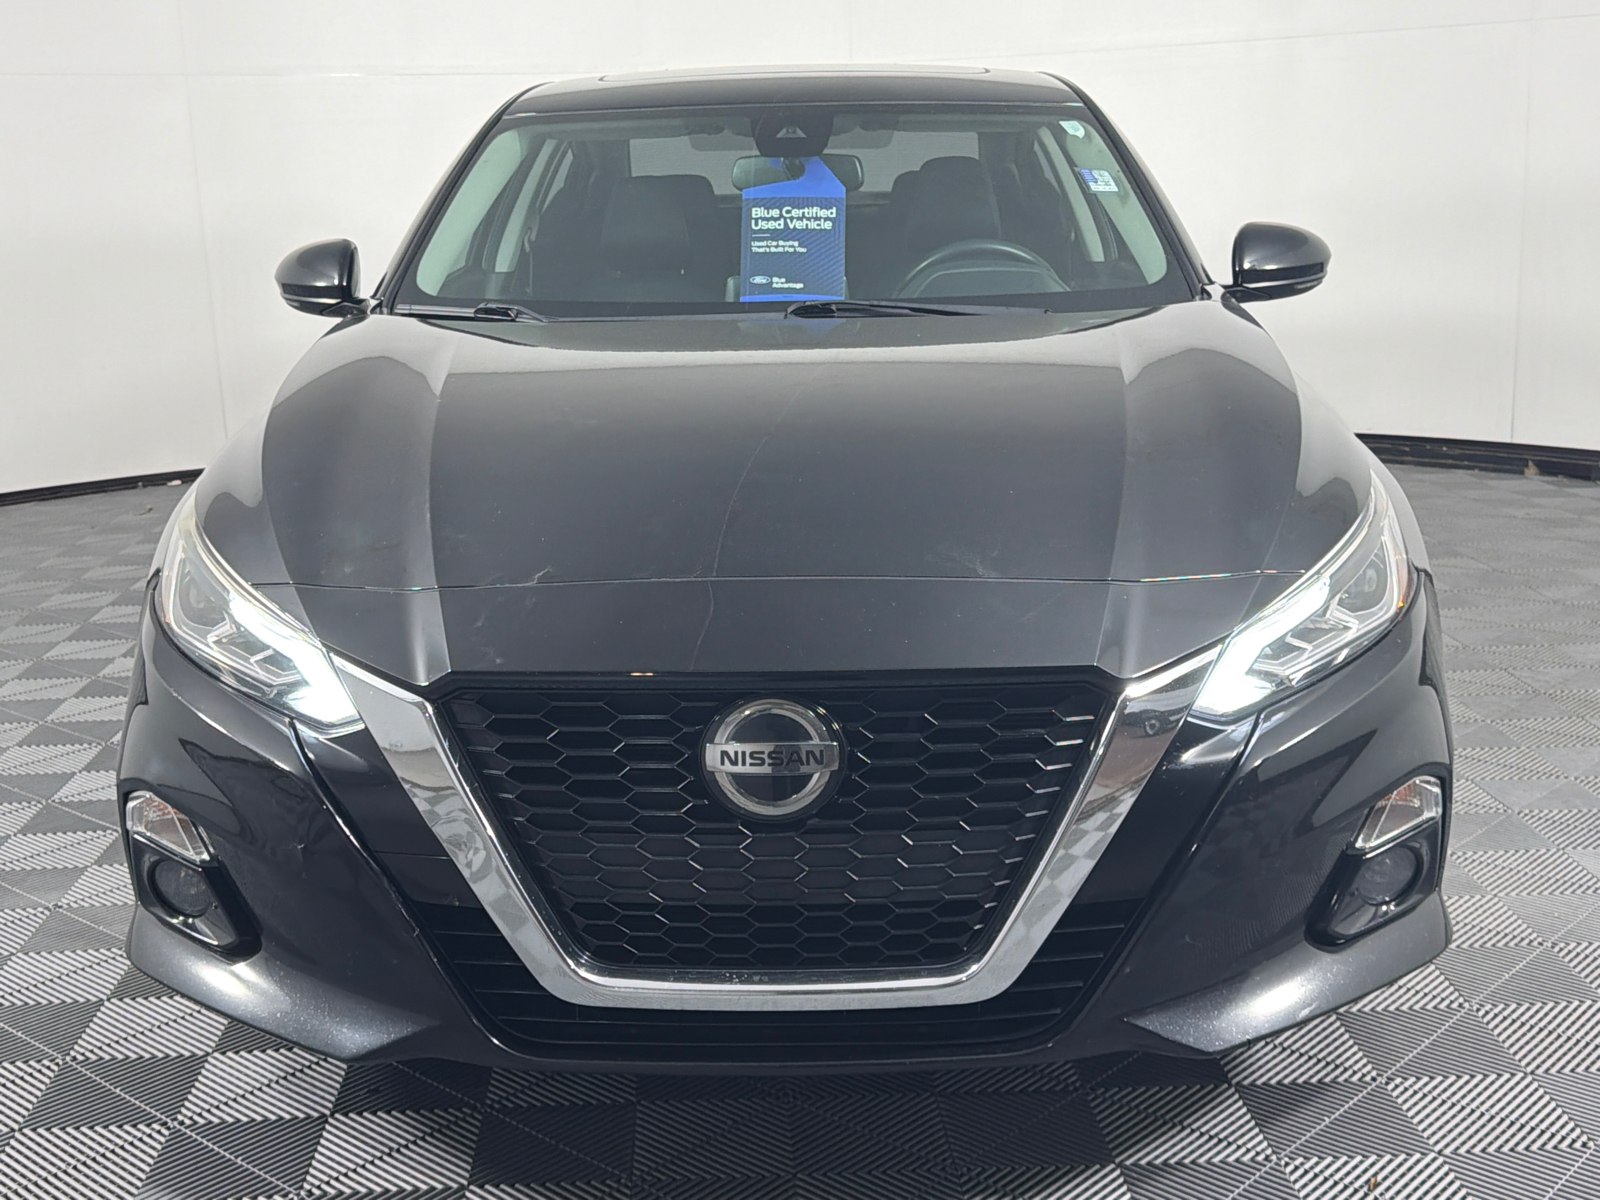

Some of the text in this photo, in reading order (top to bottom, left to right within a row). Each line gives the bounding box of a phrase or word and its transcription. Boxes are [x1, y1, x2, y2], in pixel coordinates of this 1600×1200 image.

[751, 206, 837, 218] Blue Certified
[751, 218, 833, 230] Used Vehicle
[720, 750, 825, 767] NISSAN
